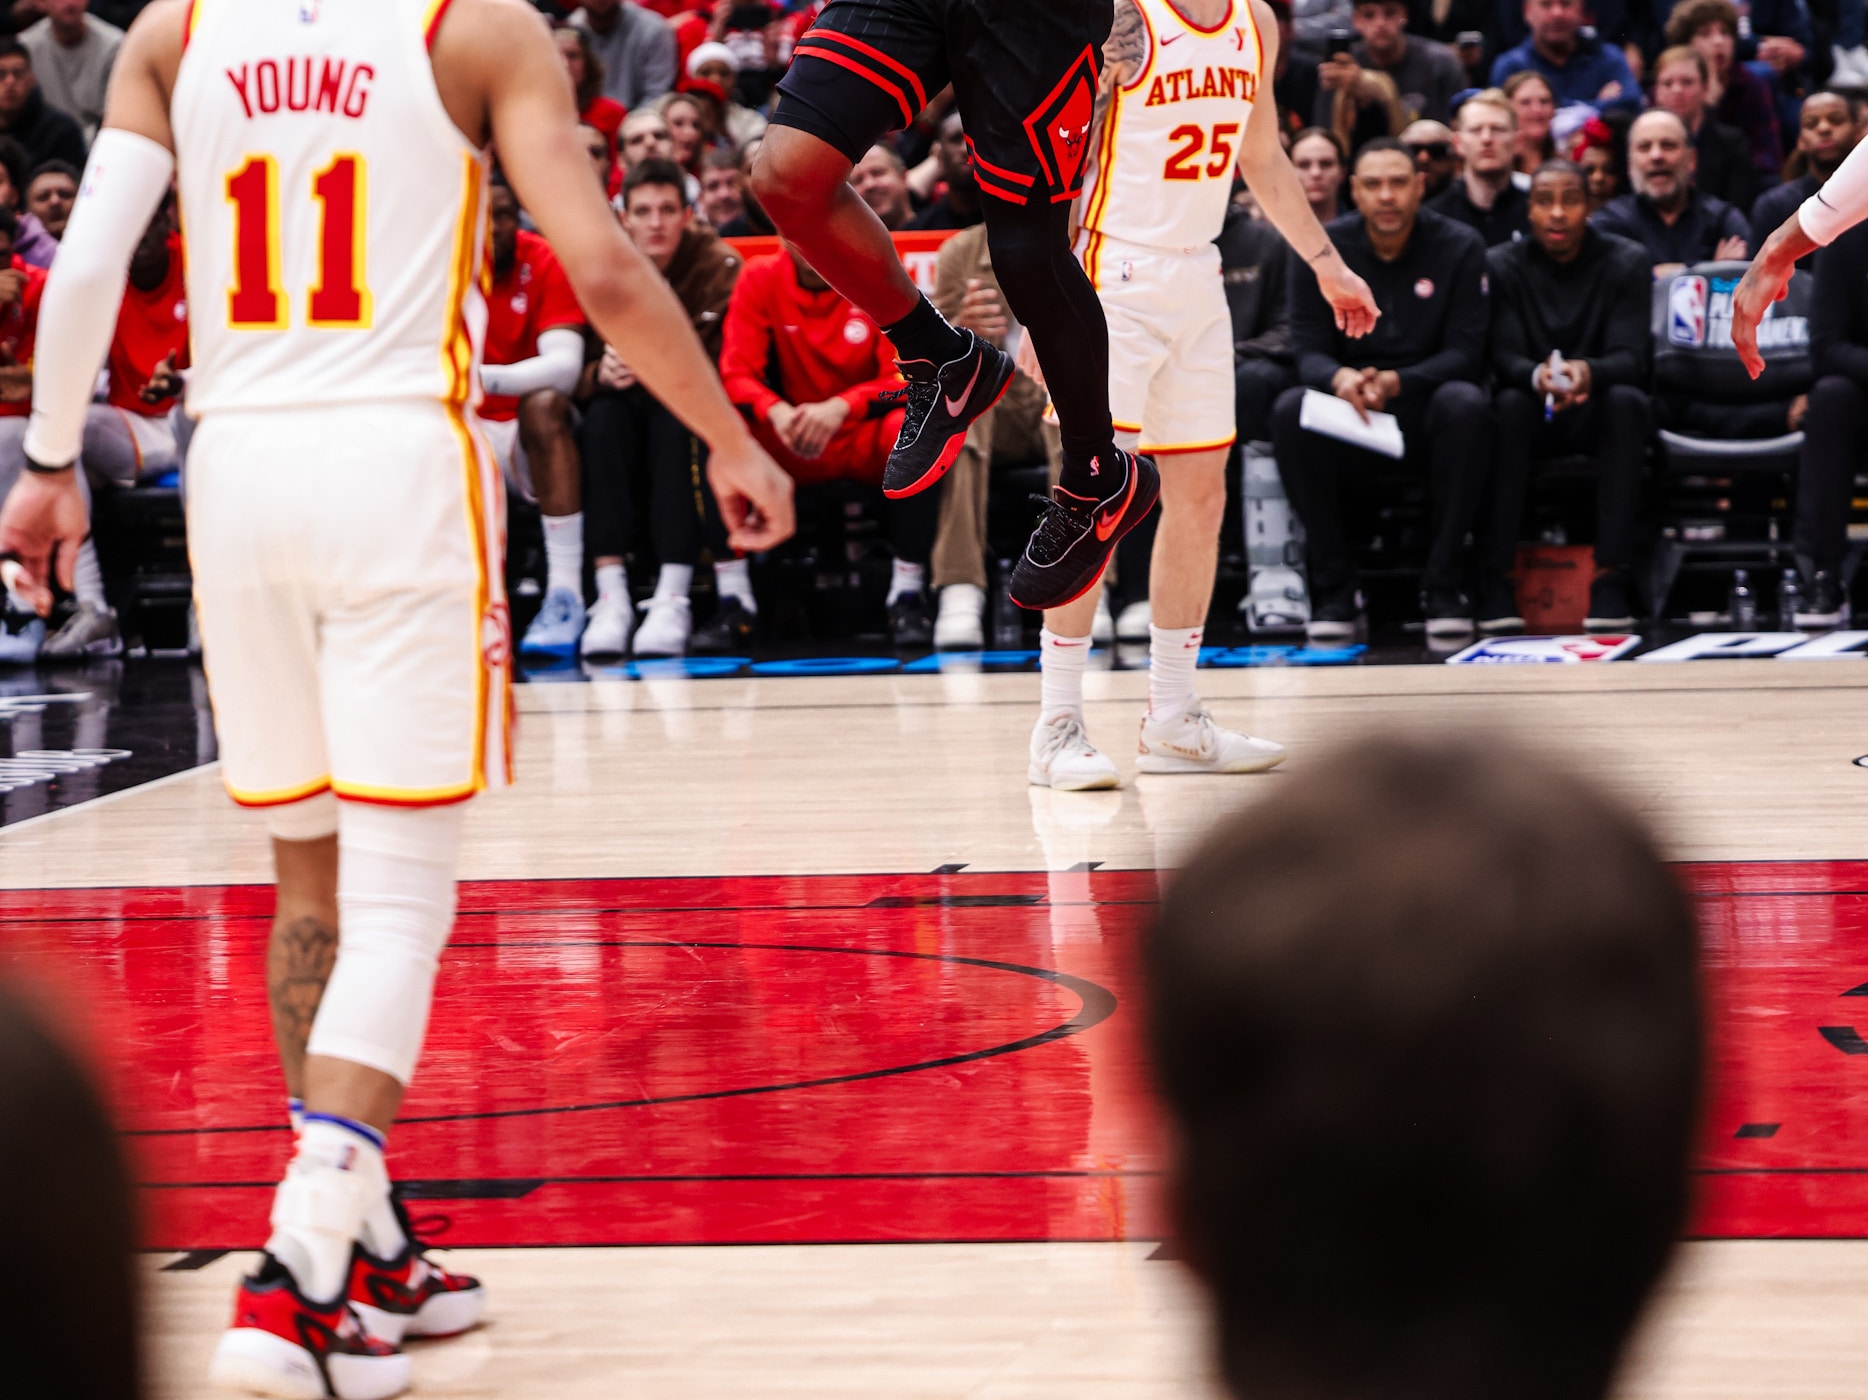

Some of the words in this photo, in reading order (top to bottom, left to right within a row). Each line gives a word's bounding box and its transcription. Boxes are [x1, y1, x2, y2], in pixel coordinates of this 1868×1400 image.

[226, 56, 375, 121] YOUNG
[1163, 122, 1241, 183] 25
[224, 150, 375, 332] 11
